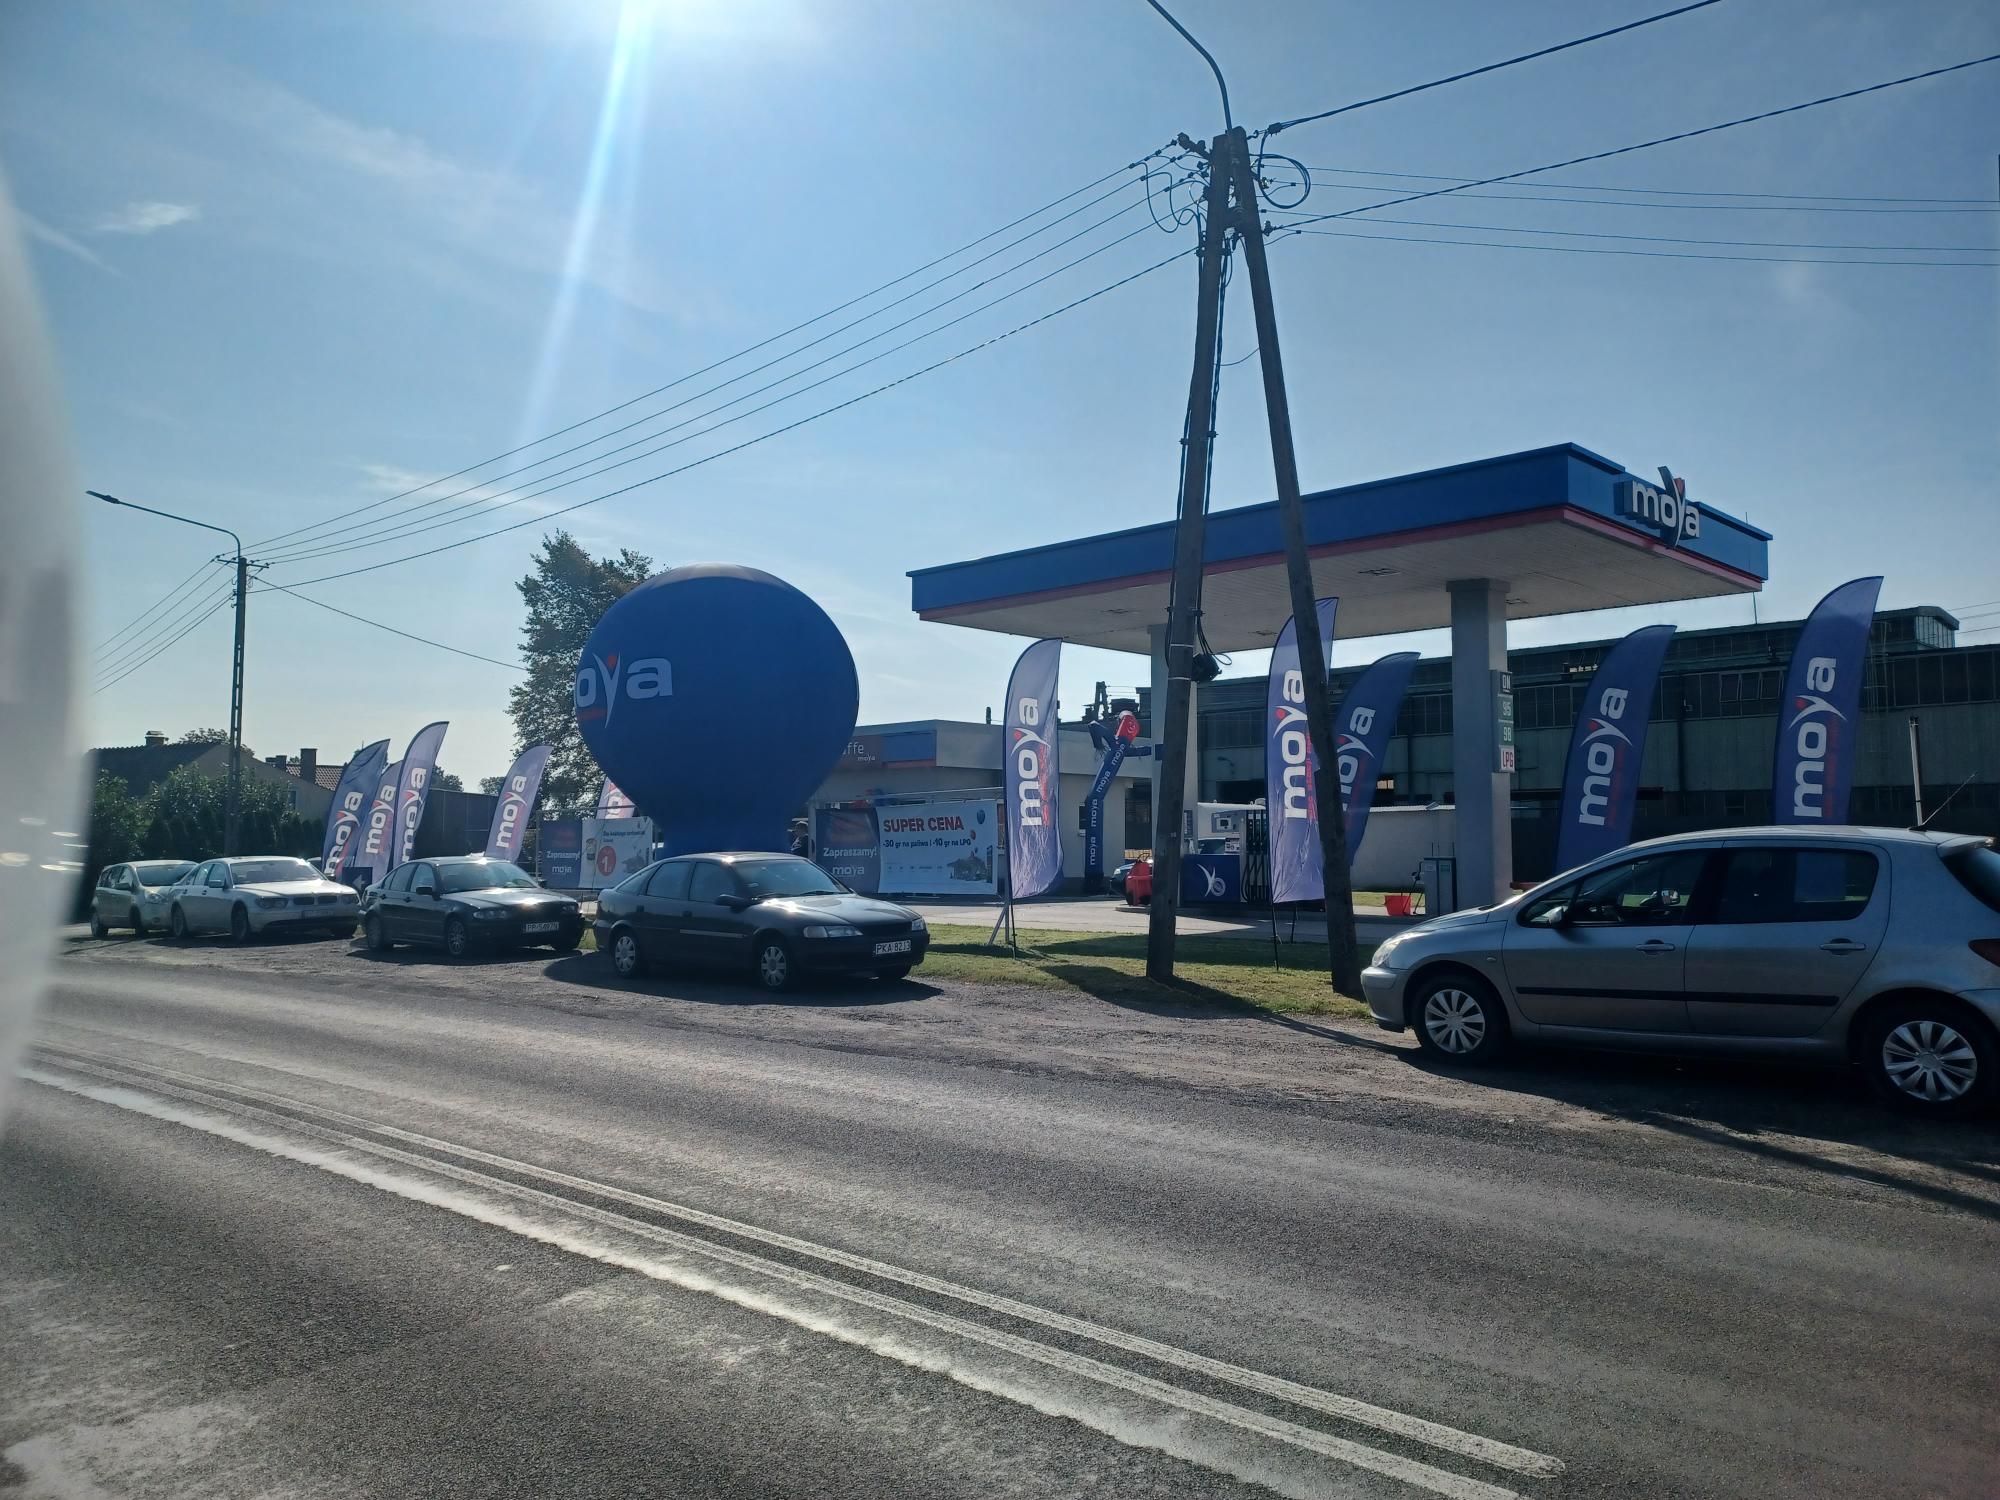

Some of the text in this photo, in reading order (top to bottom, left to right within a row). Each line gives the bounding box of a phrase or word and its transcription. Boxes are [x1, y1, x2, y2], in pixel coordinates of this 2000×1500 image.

[576, 651, 673, 729] oya
[1502, 674, 1511, 690] ON
[842, 741, 864, 755] ffe
[1579, 687, 1633, 826] moya
[1788, 656, 1847, 818] moya
[1011, 697, 1052, 826] moya
[1502, 751, 1514, 768] LPG
[365, 785, 397, 854] moya
[496, 775, 528, 848] moya
[883, 816, 965, 832] SUPER CENA
[323, 791, 364, 876] moya
[823, 847, 878, 859] Zapraszamy!
[883, 840, 894, 848] -30
[933, 838, 943, 847] -10
[832, 865, 865, 878] moya
